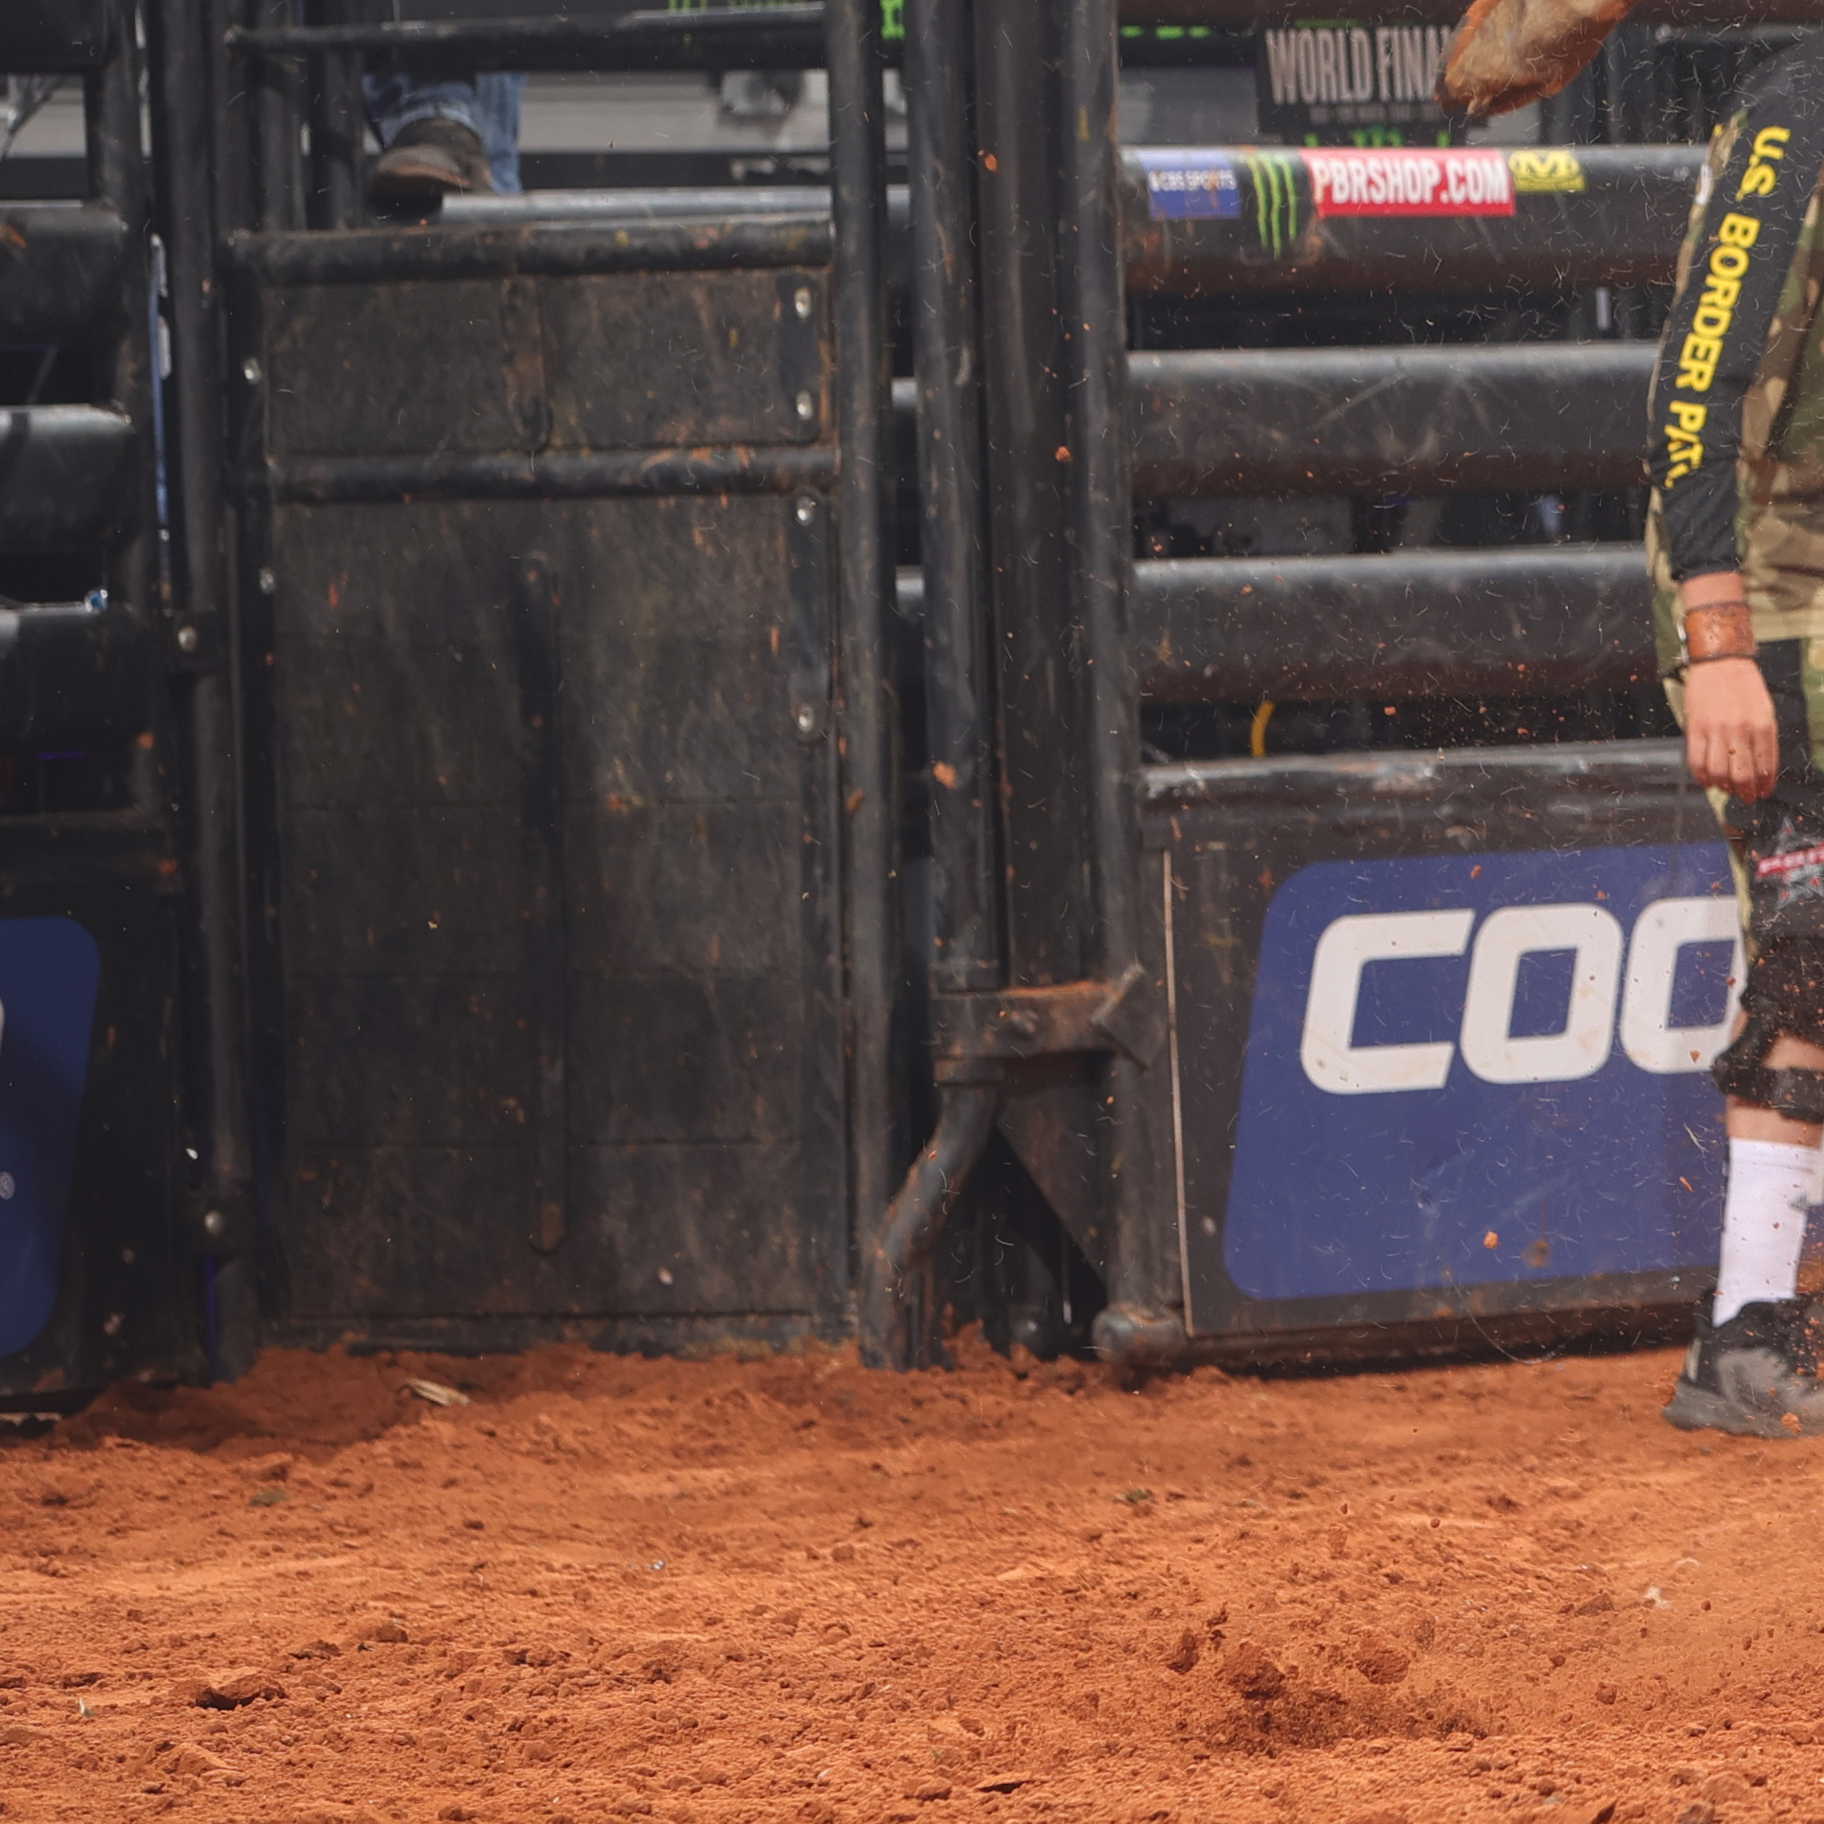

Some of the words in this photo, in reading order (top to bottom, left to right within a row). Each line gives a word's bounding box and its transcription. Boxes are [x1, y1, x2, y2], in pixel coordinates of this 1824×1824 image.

[1265, 27, 1374, 105] WORLD
[1374, 25, 1452, 102] FINA
[1309, 157, 1511, 206] PBRSHOP.COM
[1674, 212, 1761, 393] BORDER
